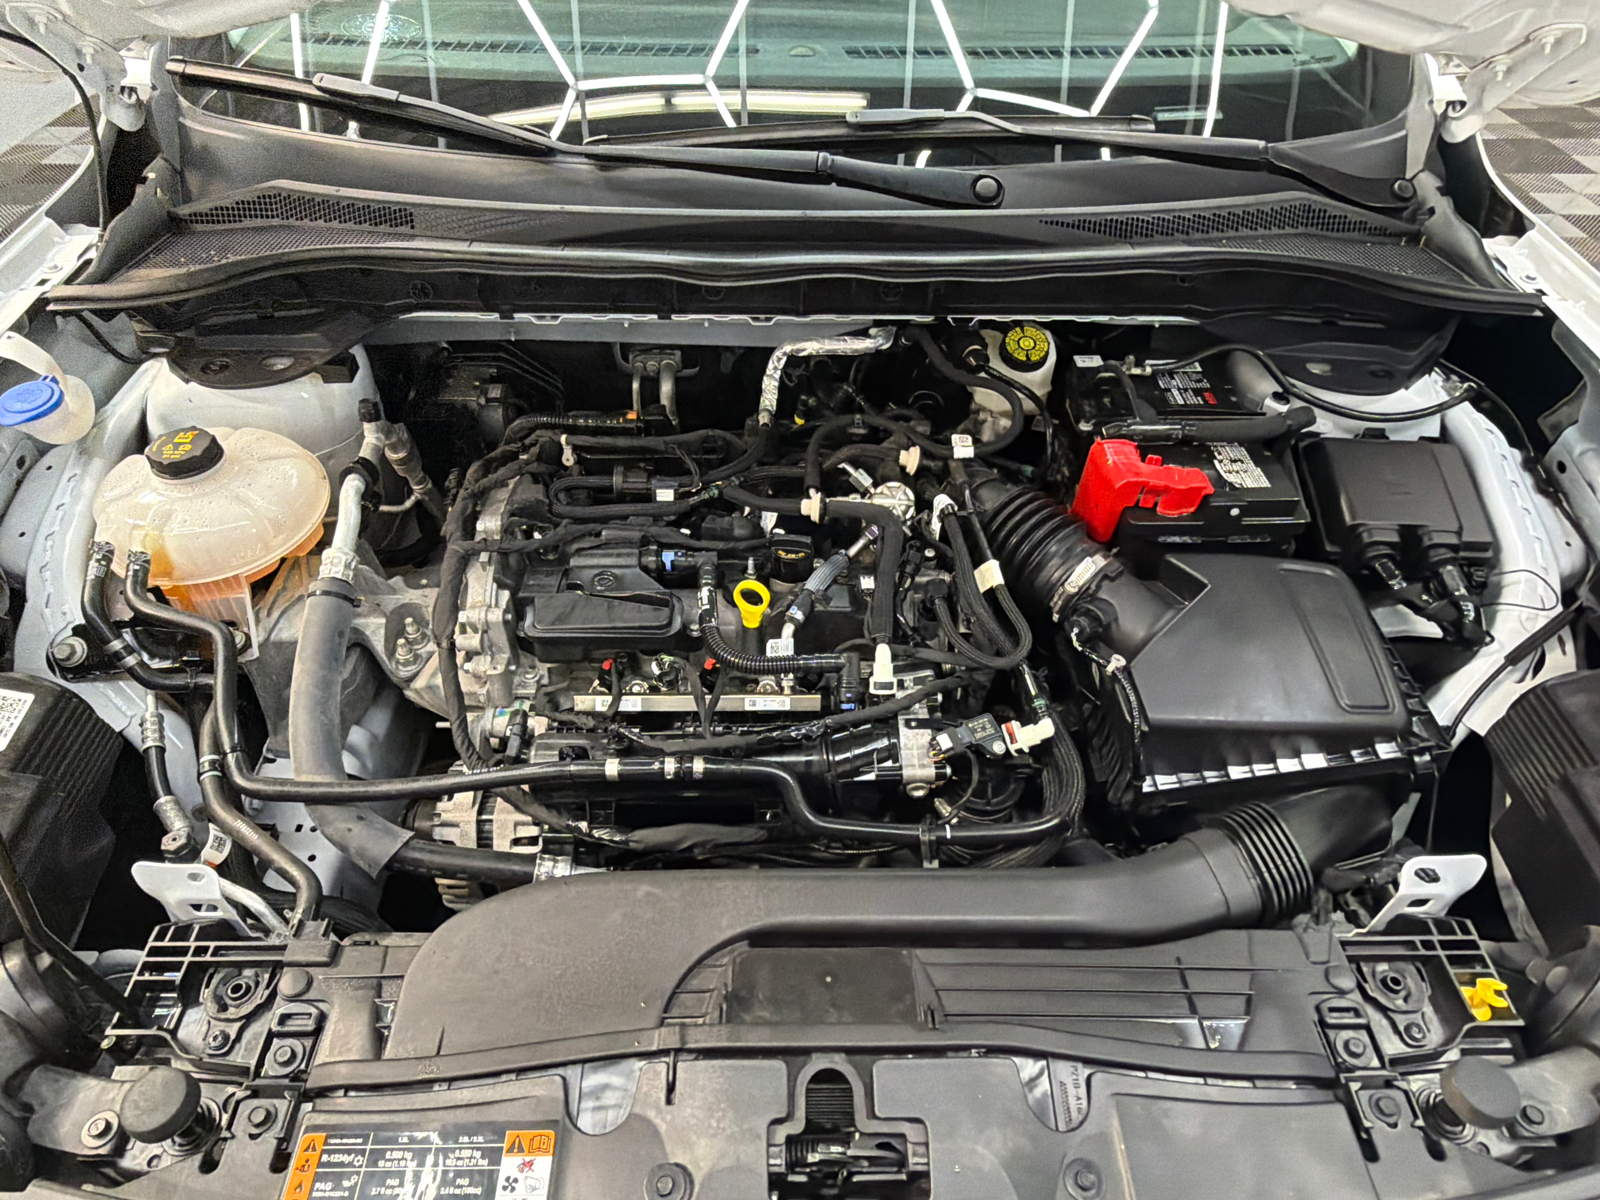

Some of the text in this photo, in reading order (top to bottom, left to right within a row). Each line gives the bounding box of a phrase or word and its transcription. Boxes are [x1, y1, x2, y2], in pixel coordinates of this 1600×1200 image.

[321, 1153, 355, 1164] R-1234yf
[404, 1150, 413, 1160] kg
[473, 1149, 482, 1159] kg
[314, 1181, 333, 1191] PAG
[385, 1178, 400, 1186] PAG
